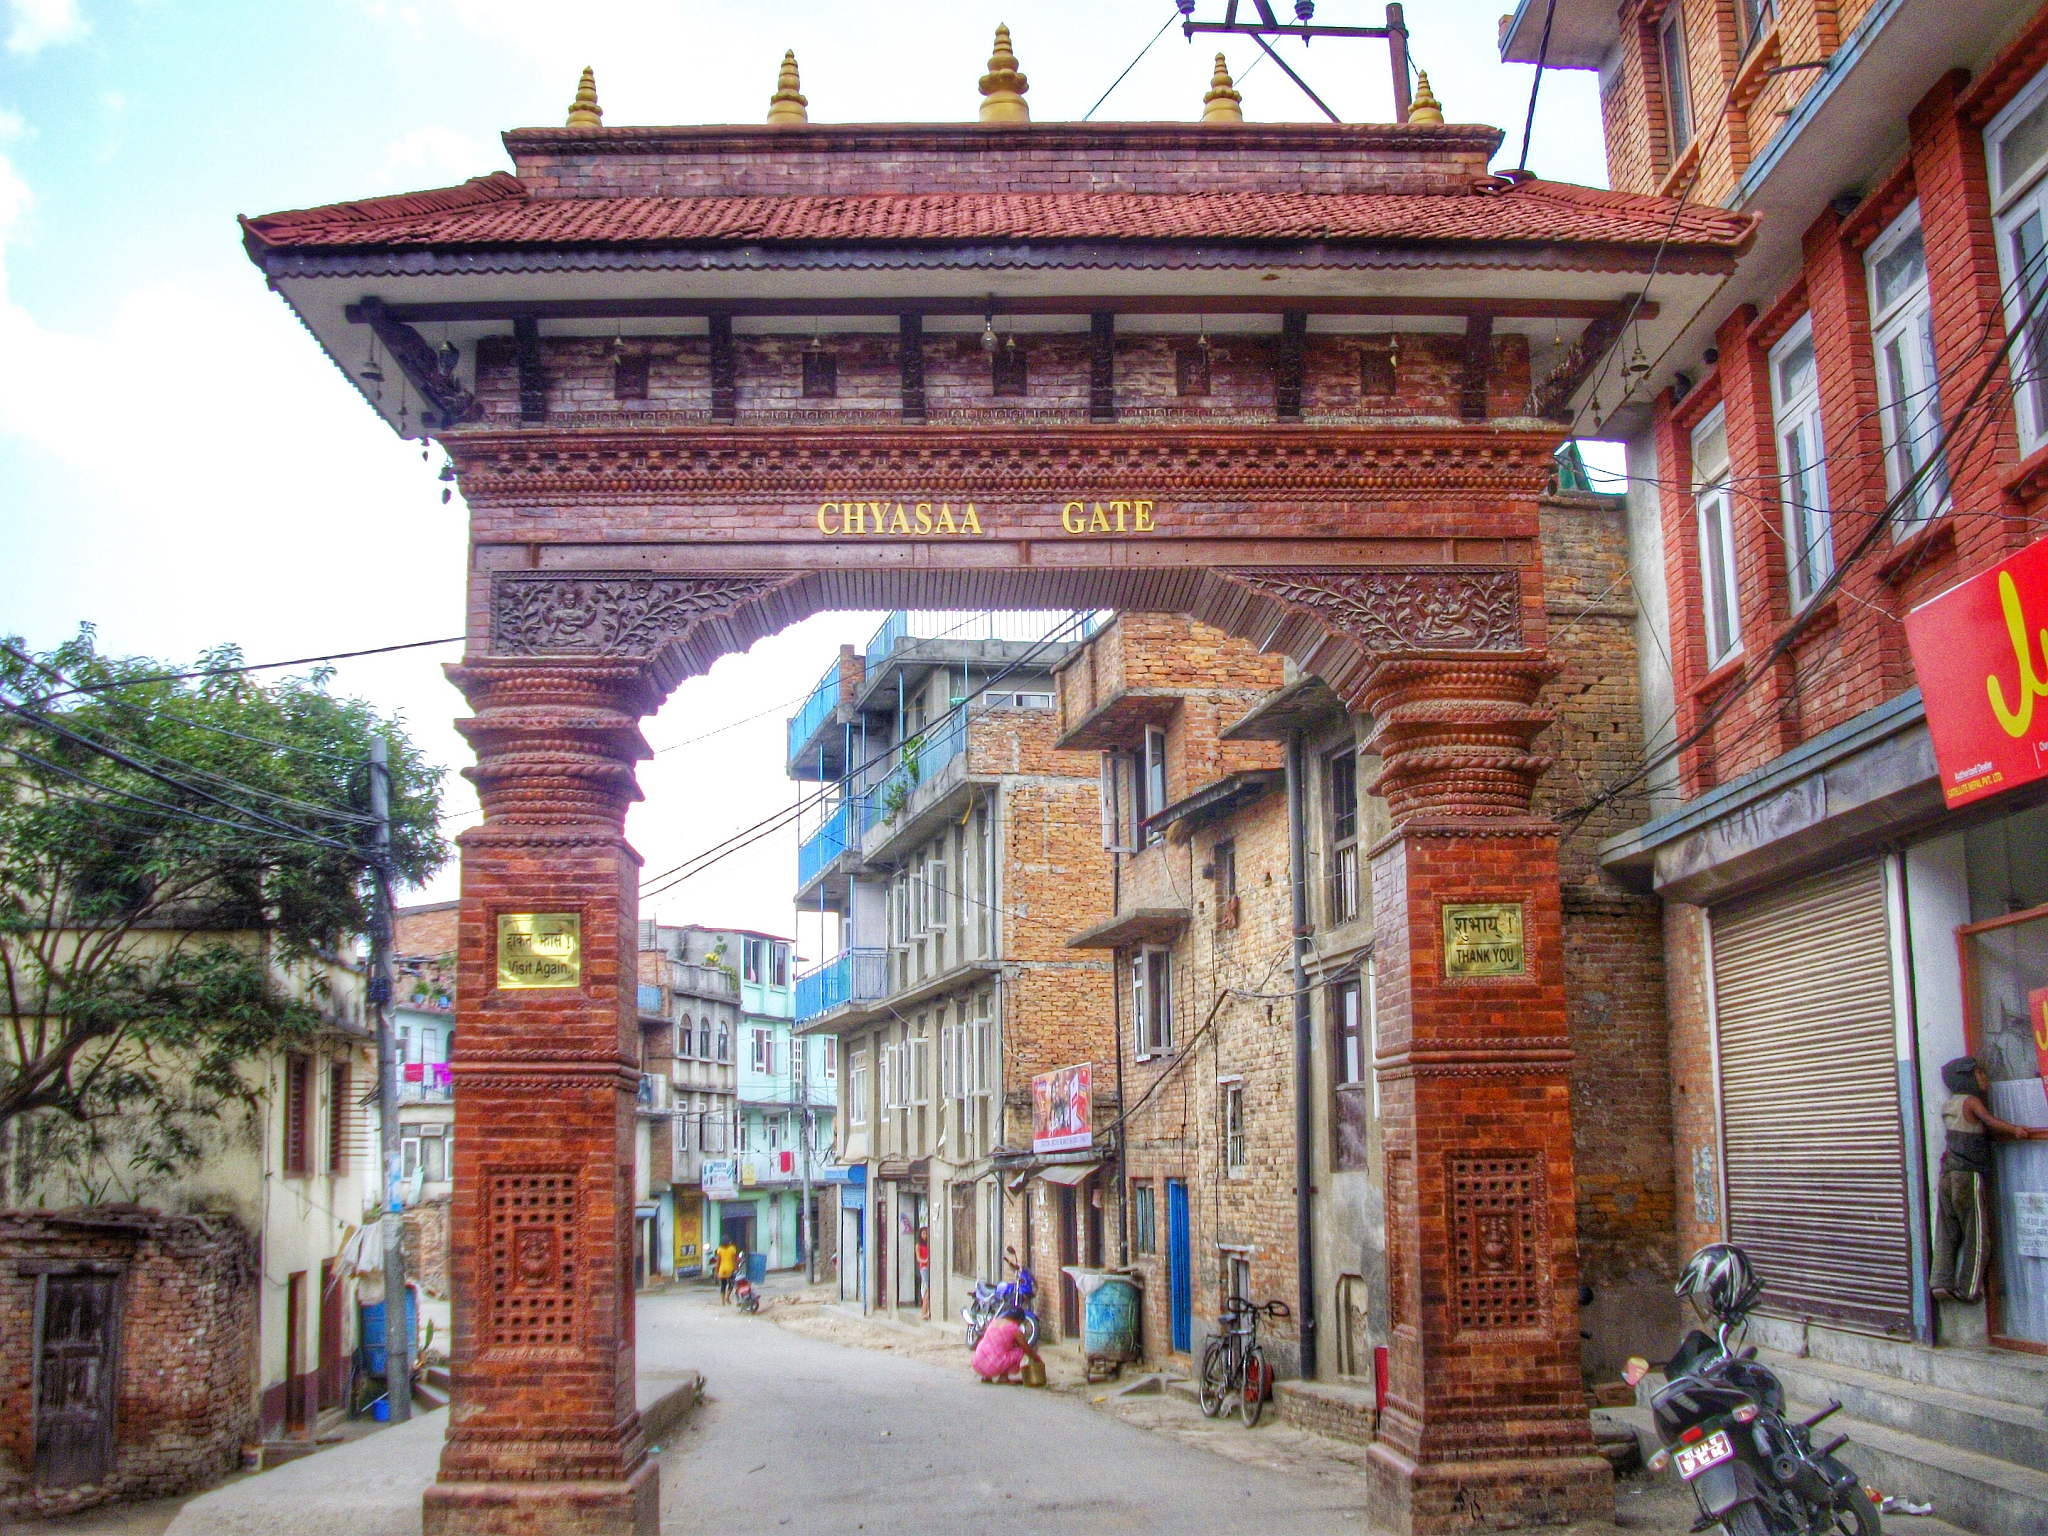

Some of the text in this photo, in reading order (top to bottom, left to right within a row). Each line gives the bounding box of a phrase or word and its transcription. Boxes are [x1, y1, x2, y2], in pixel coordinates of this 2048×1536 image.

[816, 500, 1156, 536] CHYASAA GATE
[1456, 948, 1514, 964] THANK YOU
[507, 960, 571, 978] Visit Again.
